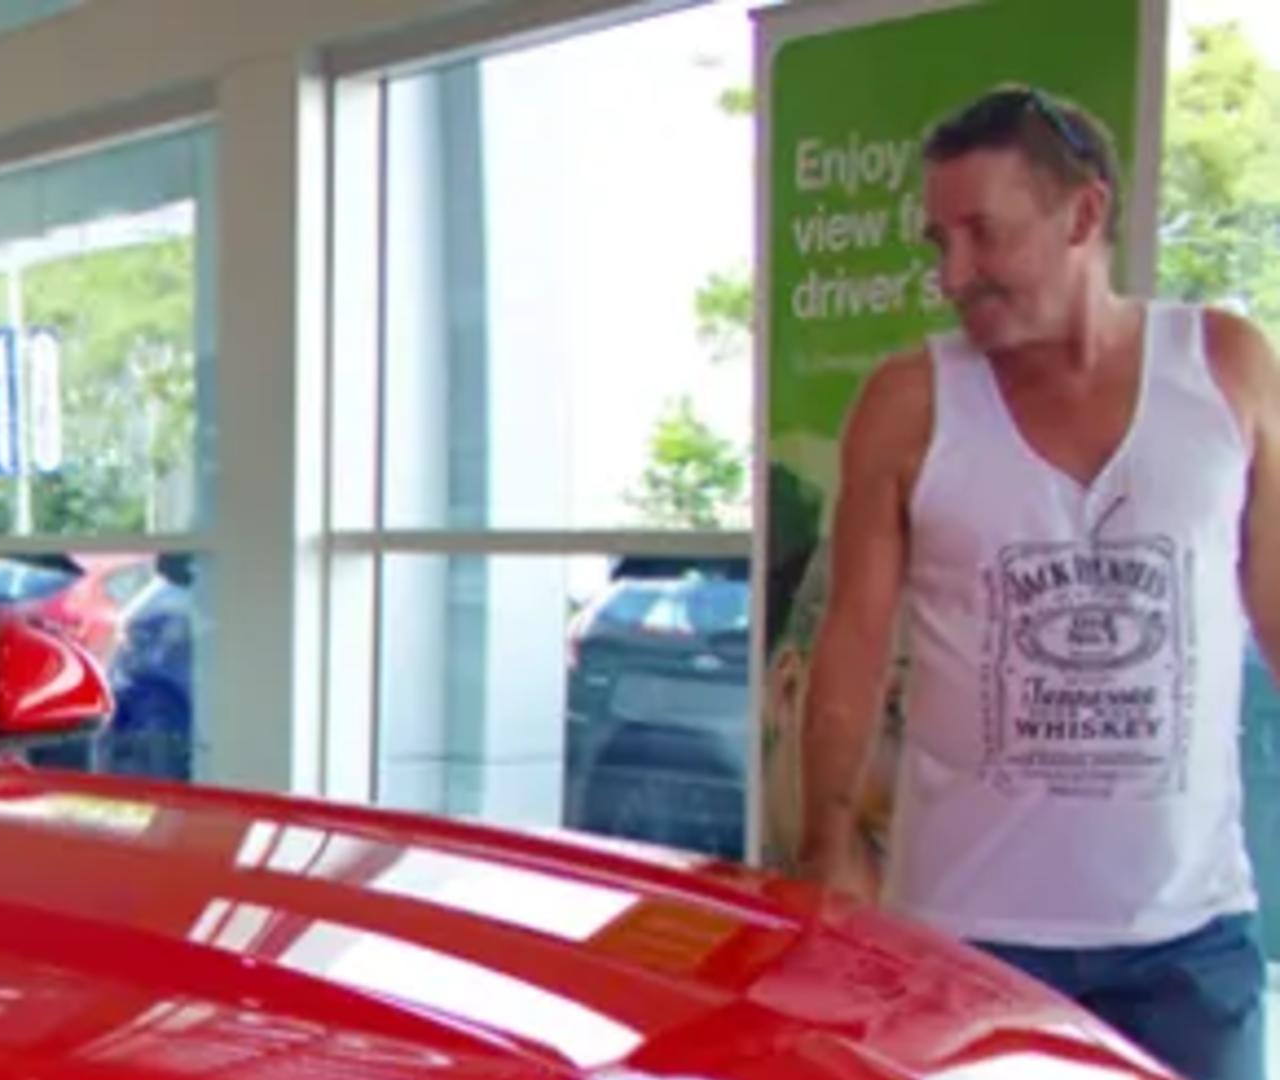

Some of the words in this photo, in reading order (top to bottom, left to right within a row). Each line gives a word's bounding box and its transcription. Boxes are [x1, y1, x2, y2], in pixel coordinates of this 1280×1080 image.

[796, 132, 915, 197] Enjoy
[792, 203, 888, 256] view
[1015, 716, 1164, 741] WHISKEY
